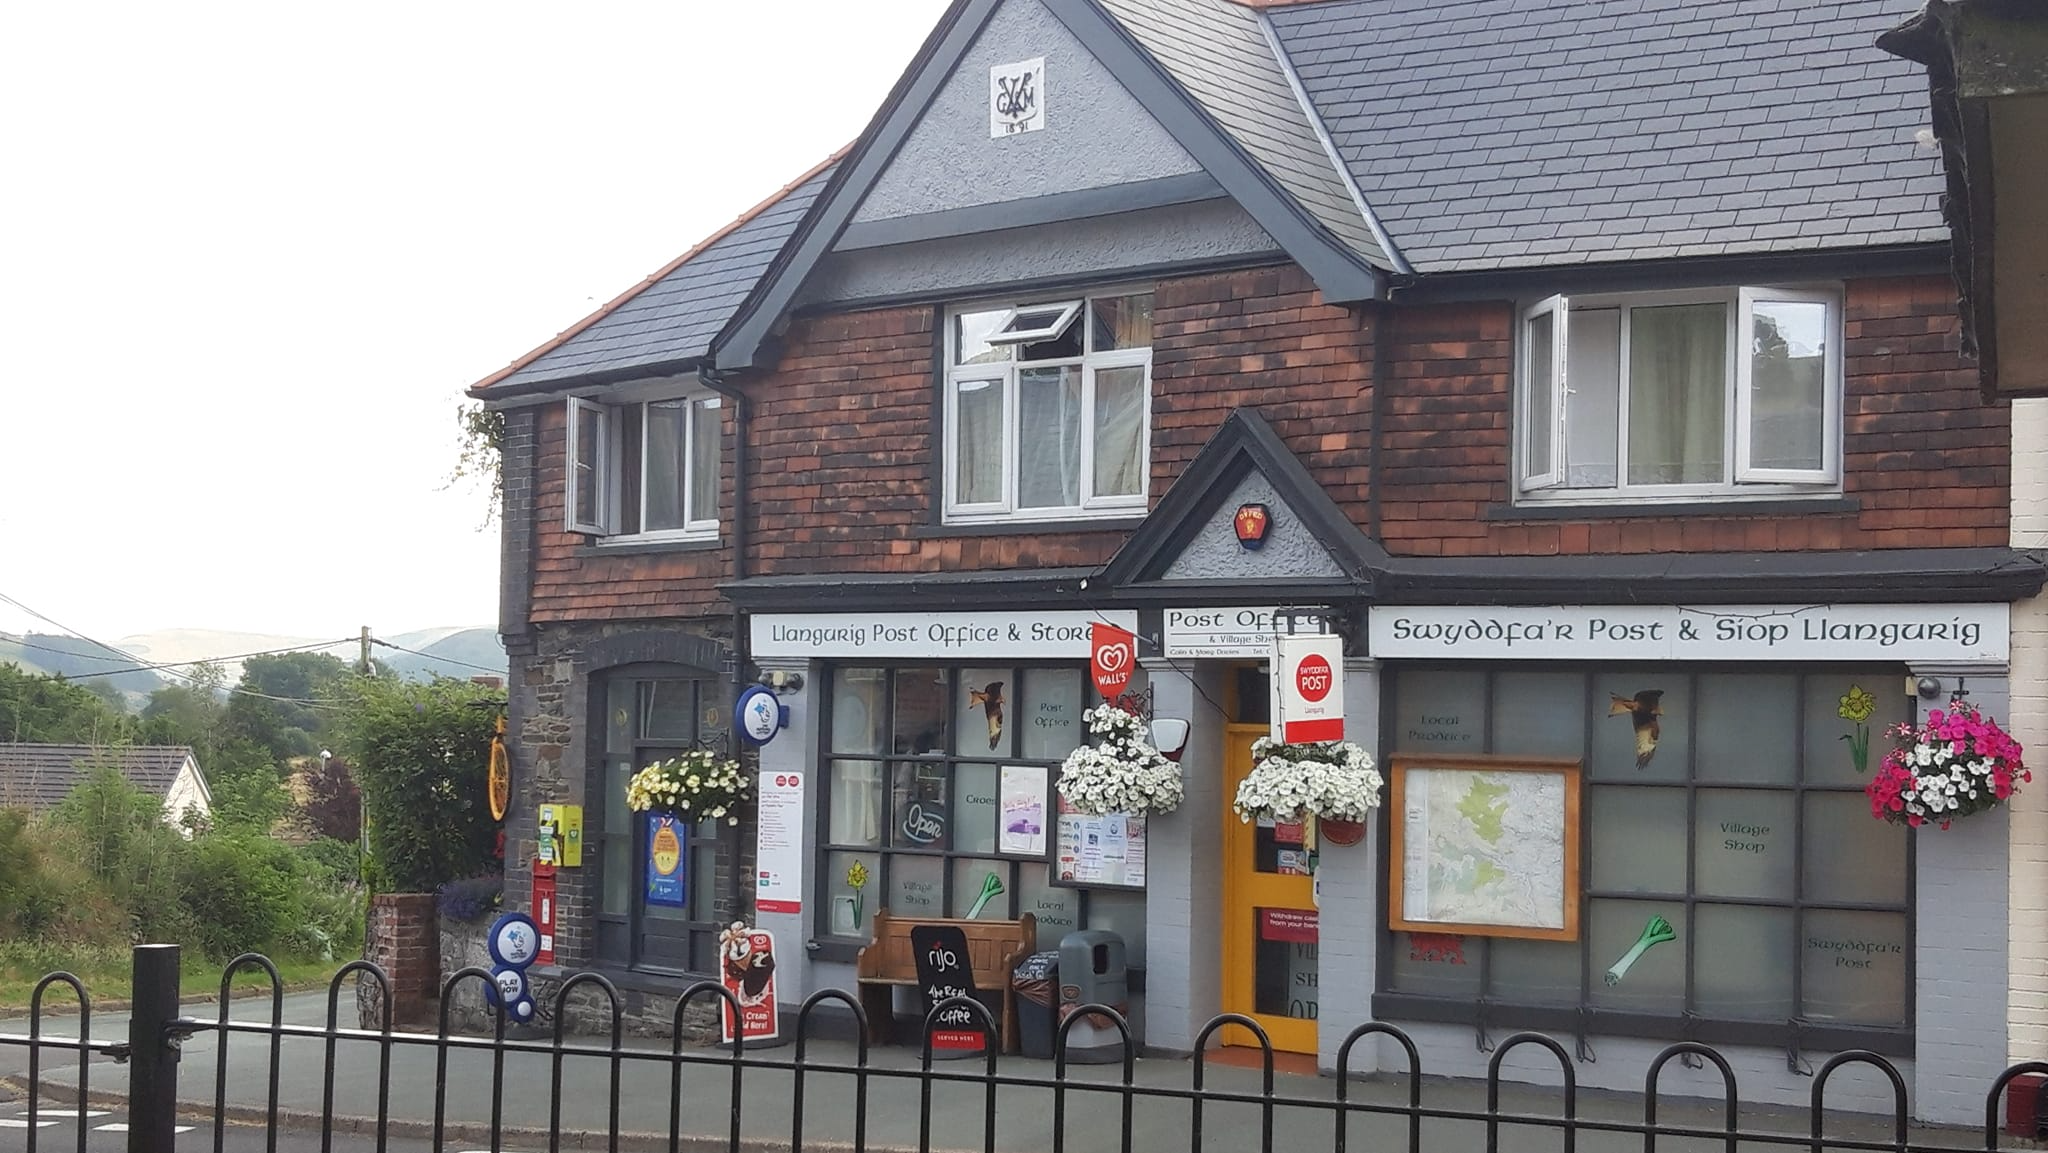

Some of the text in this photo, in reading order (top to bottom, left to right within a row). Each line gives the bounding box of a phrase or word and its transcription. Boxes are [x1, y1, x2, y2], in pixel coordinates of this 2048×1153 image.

[1169, 611, 1224, 627] Post
[772, 623, 865, 647] Llangurig
[873, 623, 918, 642] Post
[928, 623, 999, 647] Office
[1007, 622, 1021, 642] &
[1589, 618, 1664, 641] Post
[1678, 618, 1700, 641] &
[1715, 618, 1789, 646] Siop
[1803, 616, 1981, 646] Llangurig
[1209, 635, 1217, 643] &
[1220, 634, 1252, 645] Village
[1097, 673, 1127, 686] WALL'S
[1301, 676, 1328, 691] POST
[1040, 703, 1064, 712] Post
[1035, 716, 1070, 728] Office
[908, 804, 942, 838] Open
[1720, 823, 1770, 836] Village
[1724, 840, 1765, 853] Shop
[905, 895, 930, 905] Shop
[1037, 900, 1065, 910] Local
[1270, 912, 1302, 920] Withdraw
[928, 948, 957, 972] rijo
[1836, 957, 1872, 968] Post
